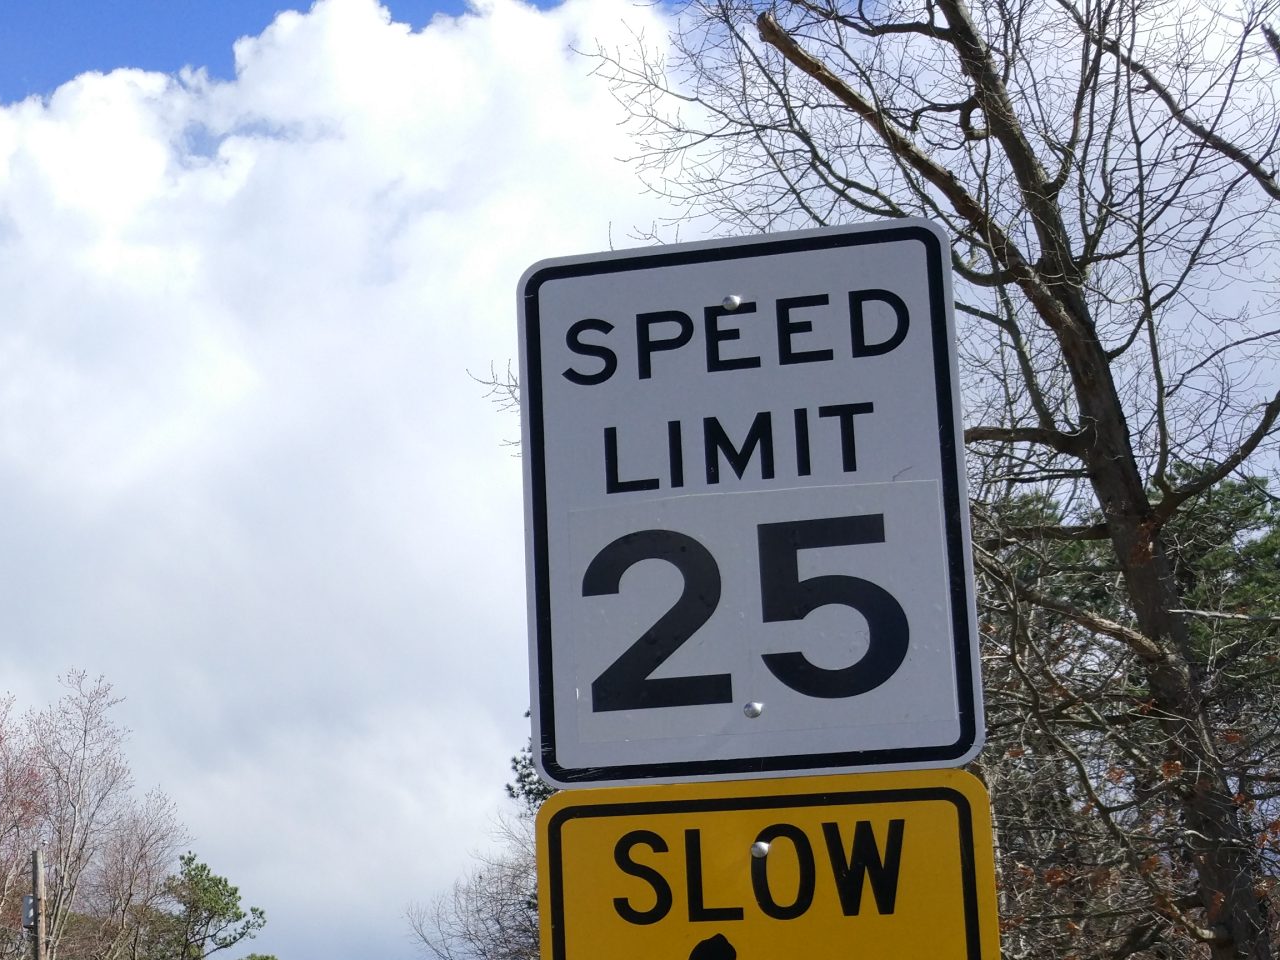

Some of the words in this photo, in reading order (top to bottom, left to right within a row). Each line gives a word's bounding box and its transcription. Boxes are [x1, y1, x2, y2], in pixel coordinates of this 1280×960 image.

[562, 289, 910, 386] SPEED
[604, 402, 874, 494] LIMIT
[582, 513, 910, 713] 25
[613, 819, 905, 926] SLOW
